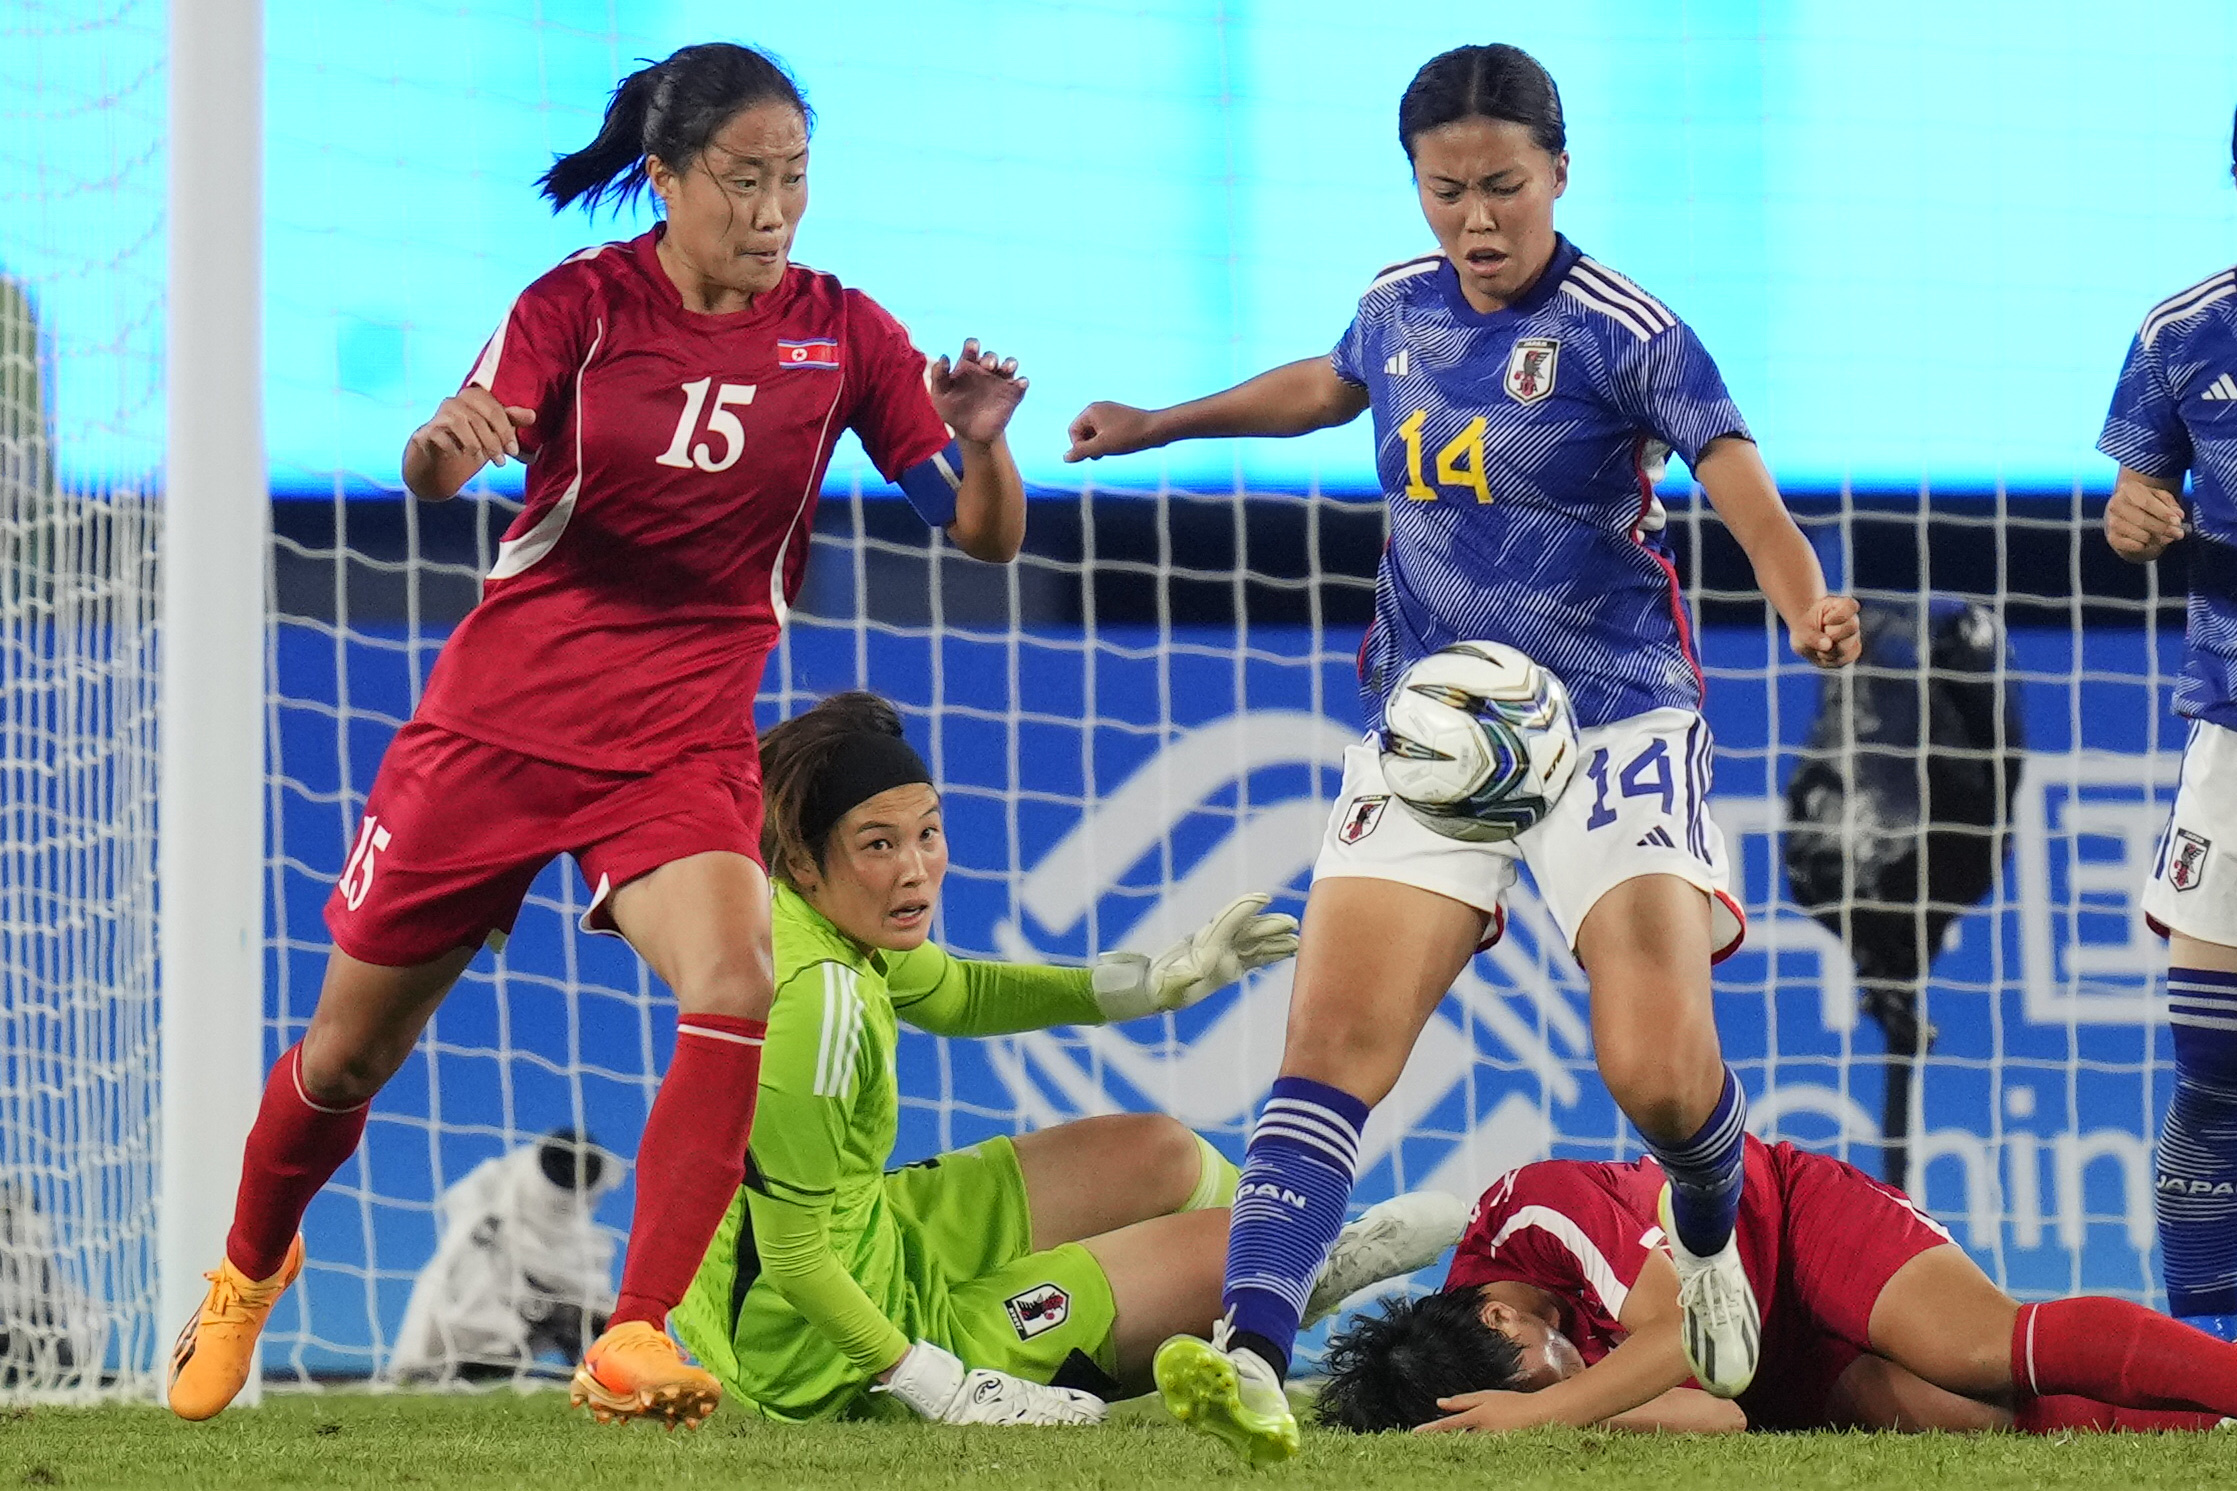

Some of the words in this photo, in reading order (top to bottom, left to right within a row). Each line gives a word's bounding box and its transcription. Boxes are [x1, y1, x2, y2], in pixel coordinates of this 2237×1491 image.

[655, 376, 757, 472] 15
[1398, 408, 1494, 504] 14
[1586, 737, 1674, 831] 14
[338, 815, 392, 911] 15
[2157, 1175, 2237, 1195] JAPA
